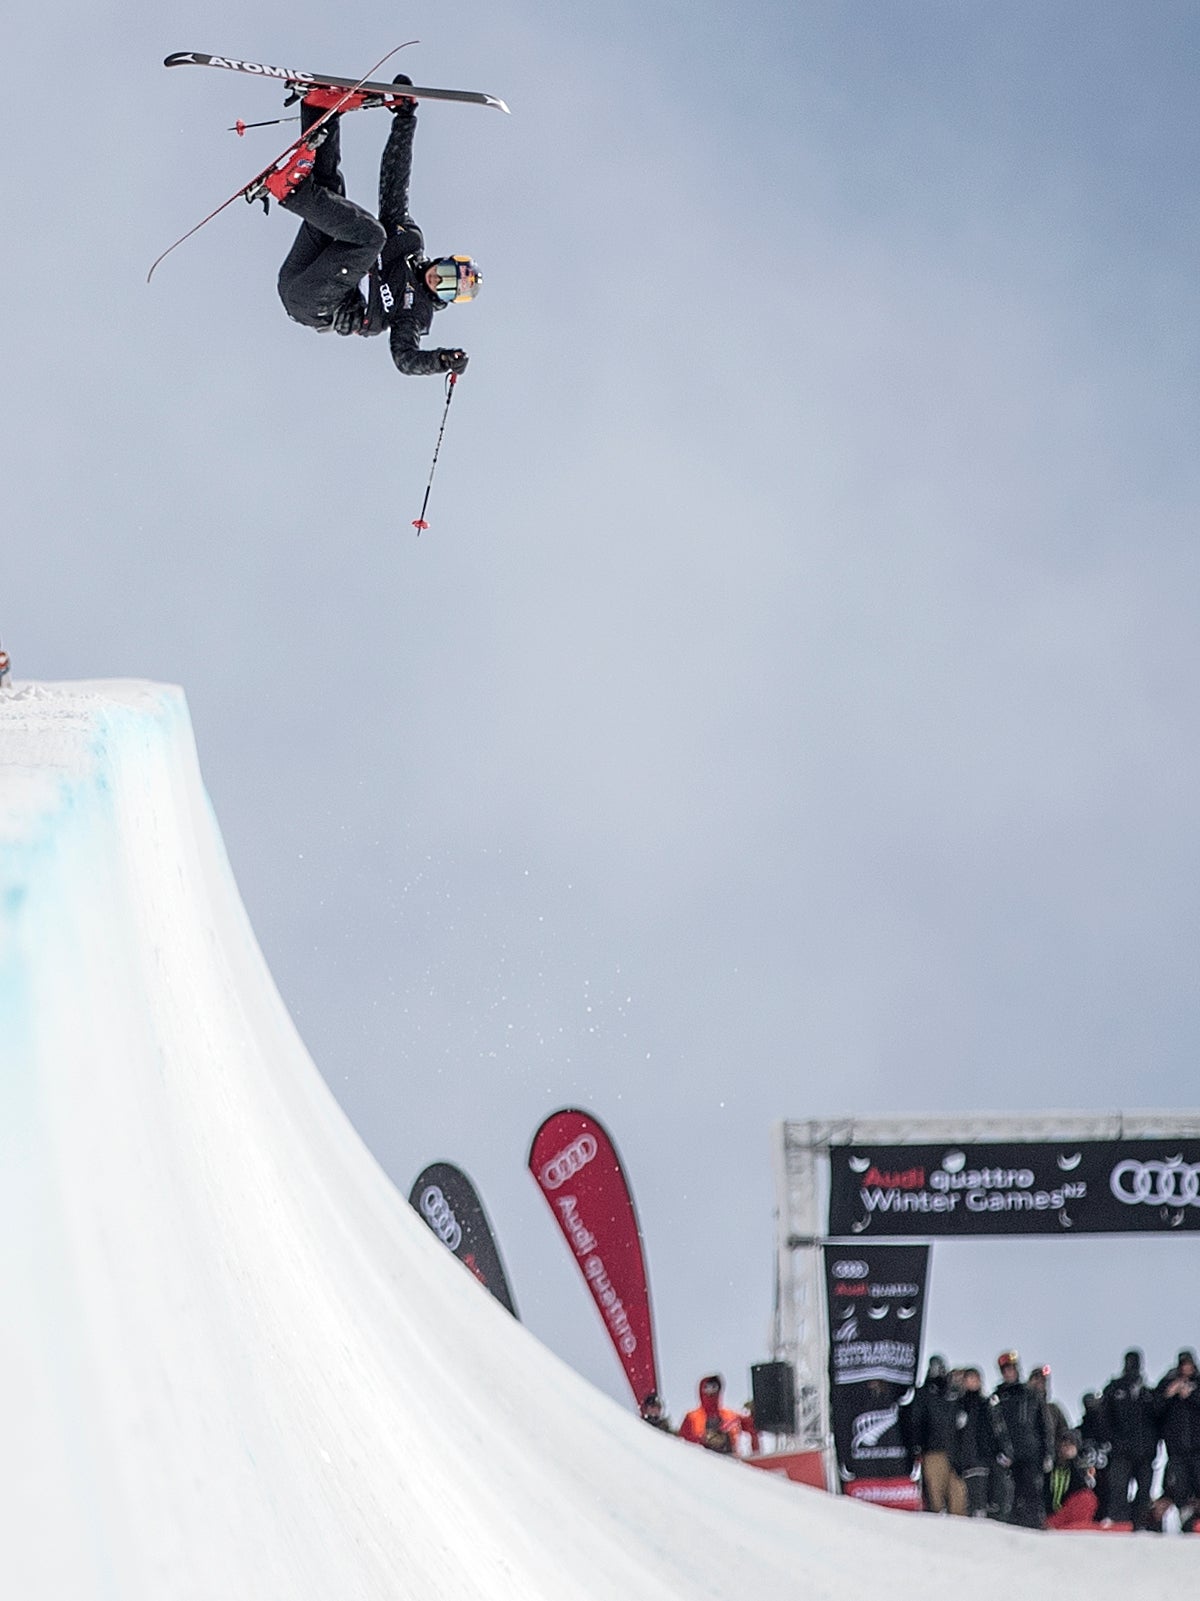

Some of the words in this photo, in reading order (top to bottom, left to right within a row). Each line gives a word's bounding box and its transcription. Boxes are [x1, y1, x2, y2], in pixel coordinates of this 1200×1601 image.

[208, 56, 315, 82] ATOMIC
[863, 1167, 925, 1190] Audi
[929, 1167, 1035, 1194] quattro
[860, 1187, 961, 1213] Winter
[557, 1195, 598, 1256] Audi
[585, 1254, 637, 1354] quattro
